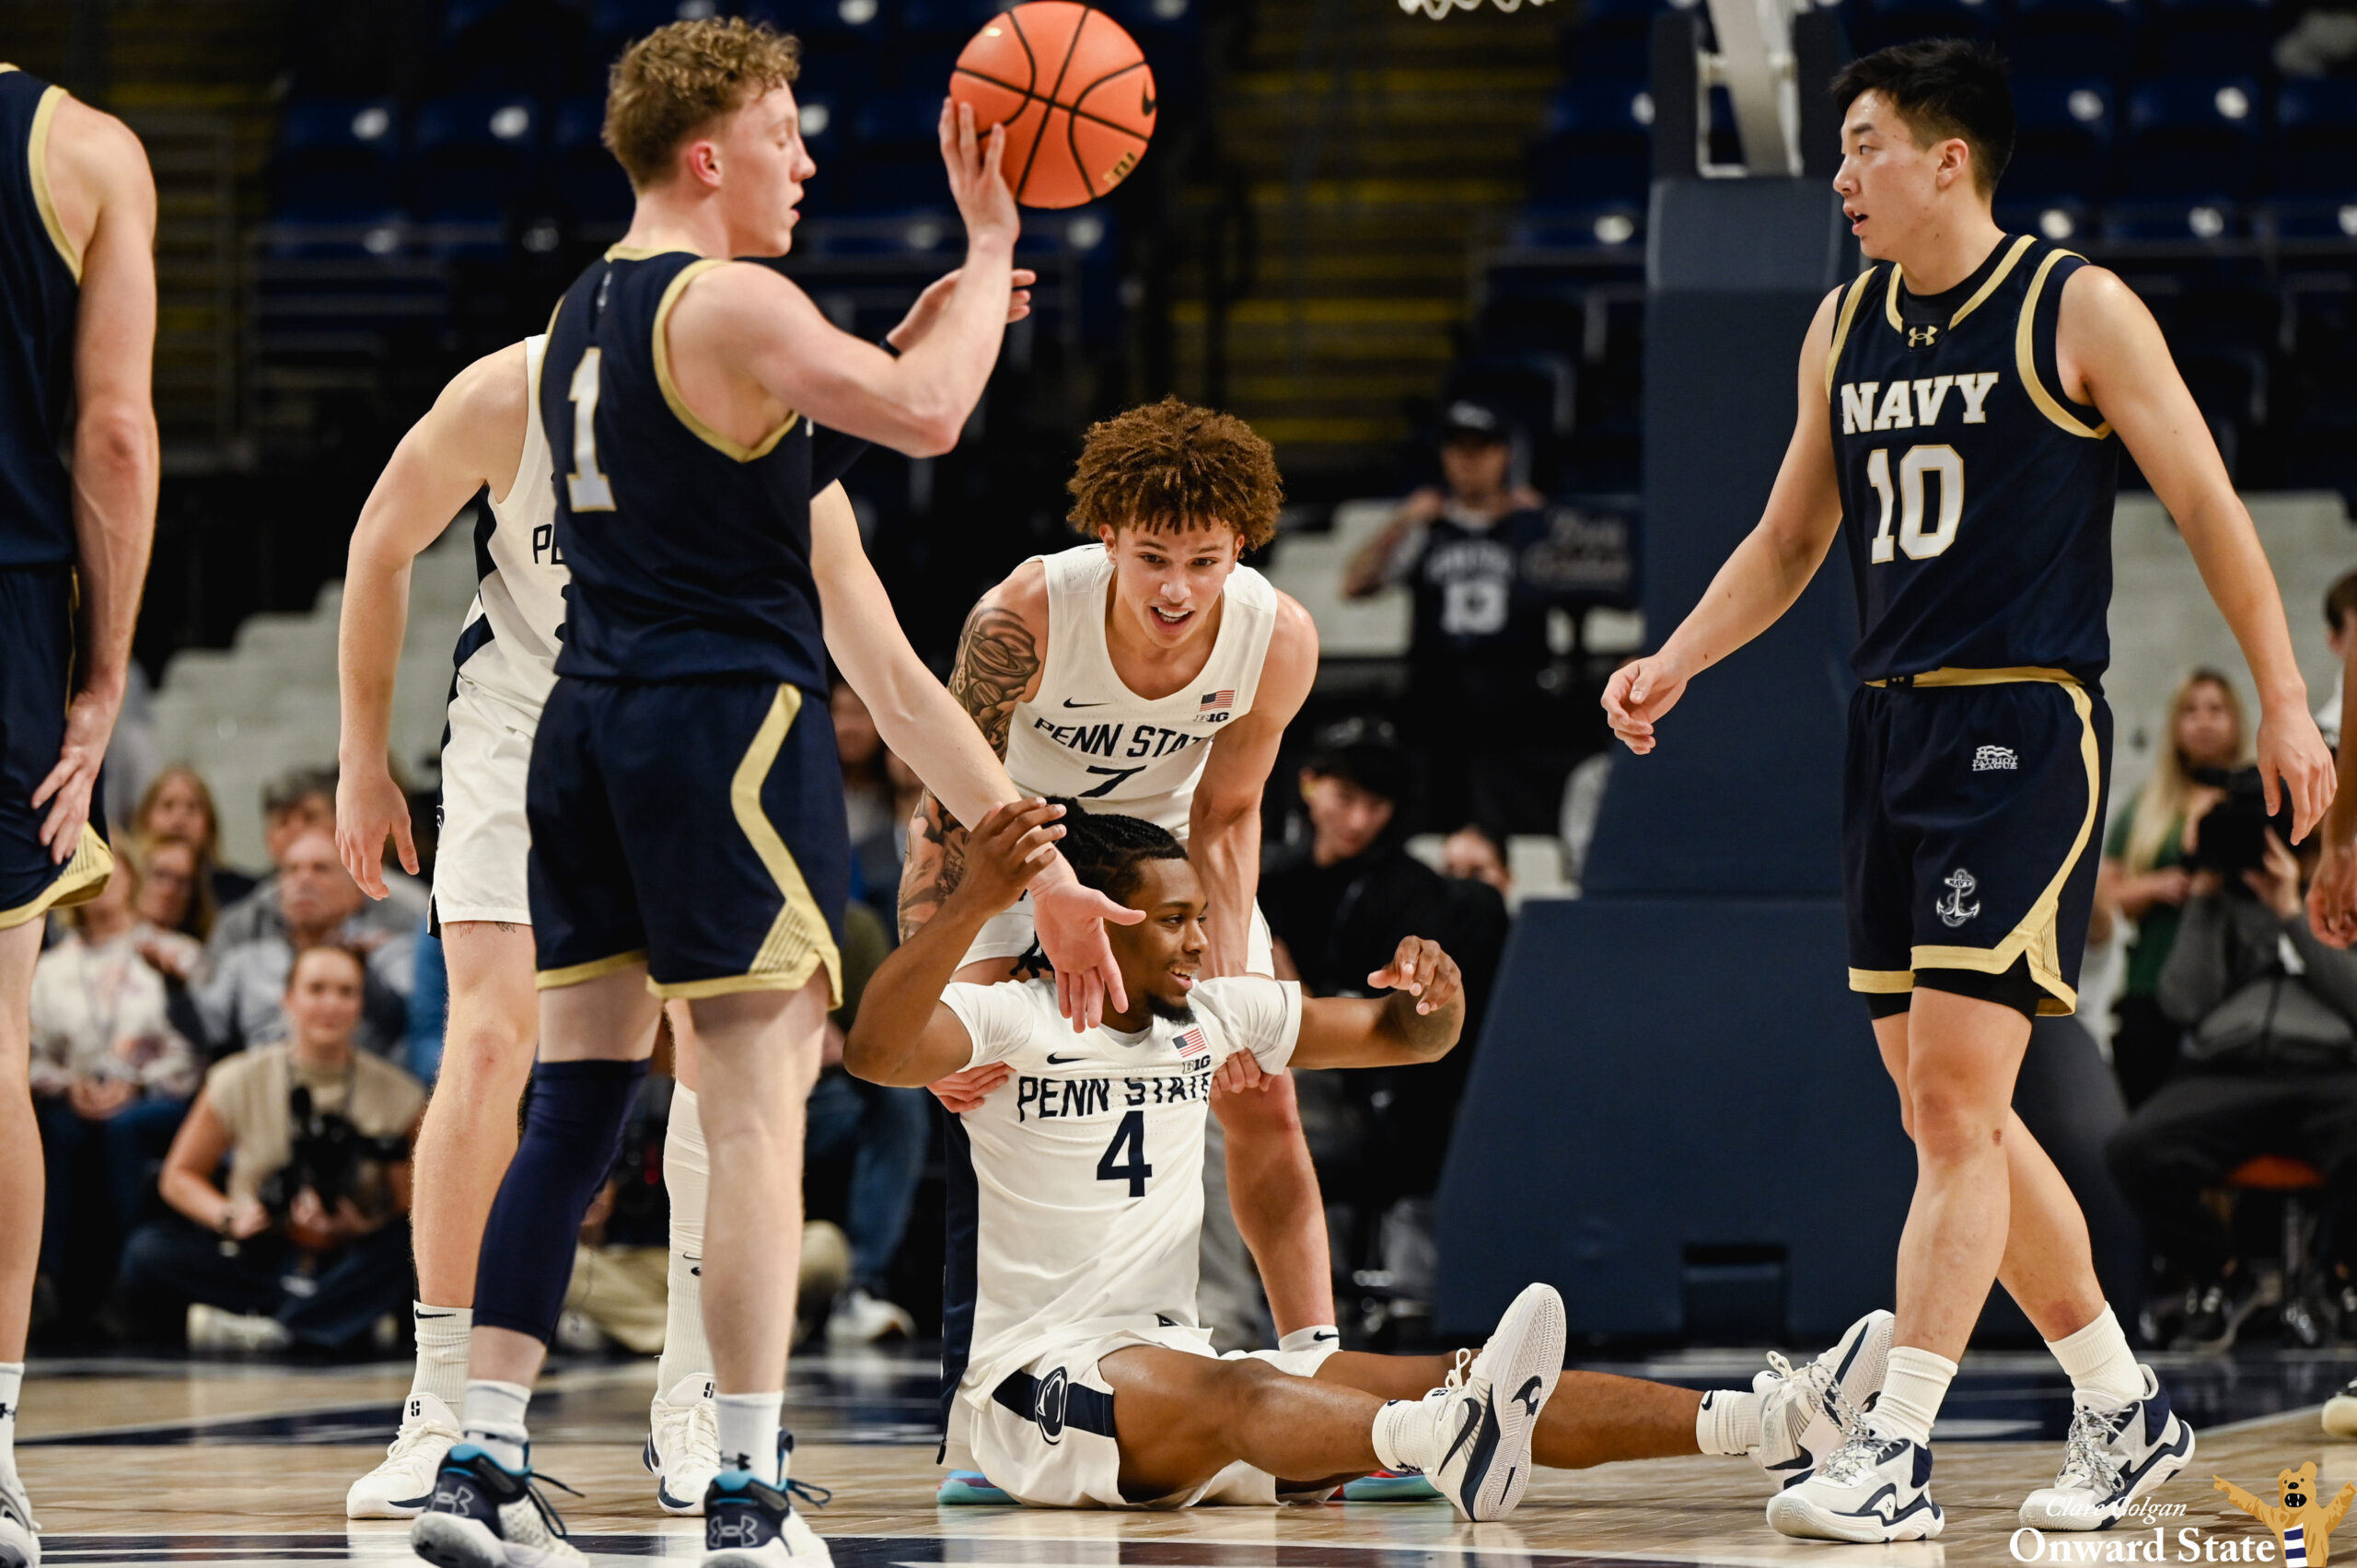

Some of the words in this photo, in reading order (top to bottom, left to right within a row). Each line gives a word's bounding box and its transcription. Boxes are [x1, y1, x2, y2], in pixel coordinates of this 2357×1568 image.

[1840, 372, 1999, 435] NAVY
[566, 347, 617, 512] 1
[1867, 444, 1965, 564] 10
[1034, 717, 1124, 757] PENN
[1972, 755, 2018, 766] PATRIOT
[1077, 765, 1148, 797] 7
[1972, 762, 2018, 772] LEAGUE
[1017, 1075, 1109, 1122] PENN
[1097, 1110, 1153, 1197] 4
